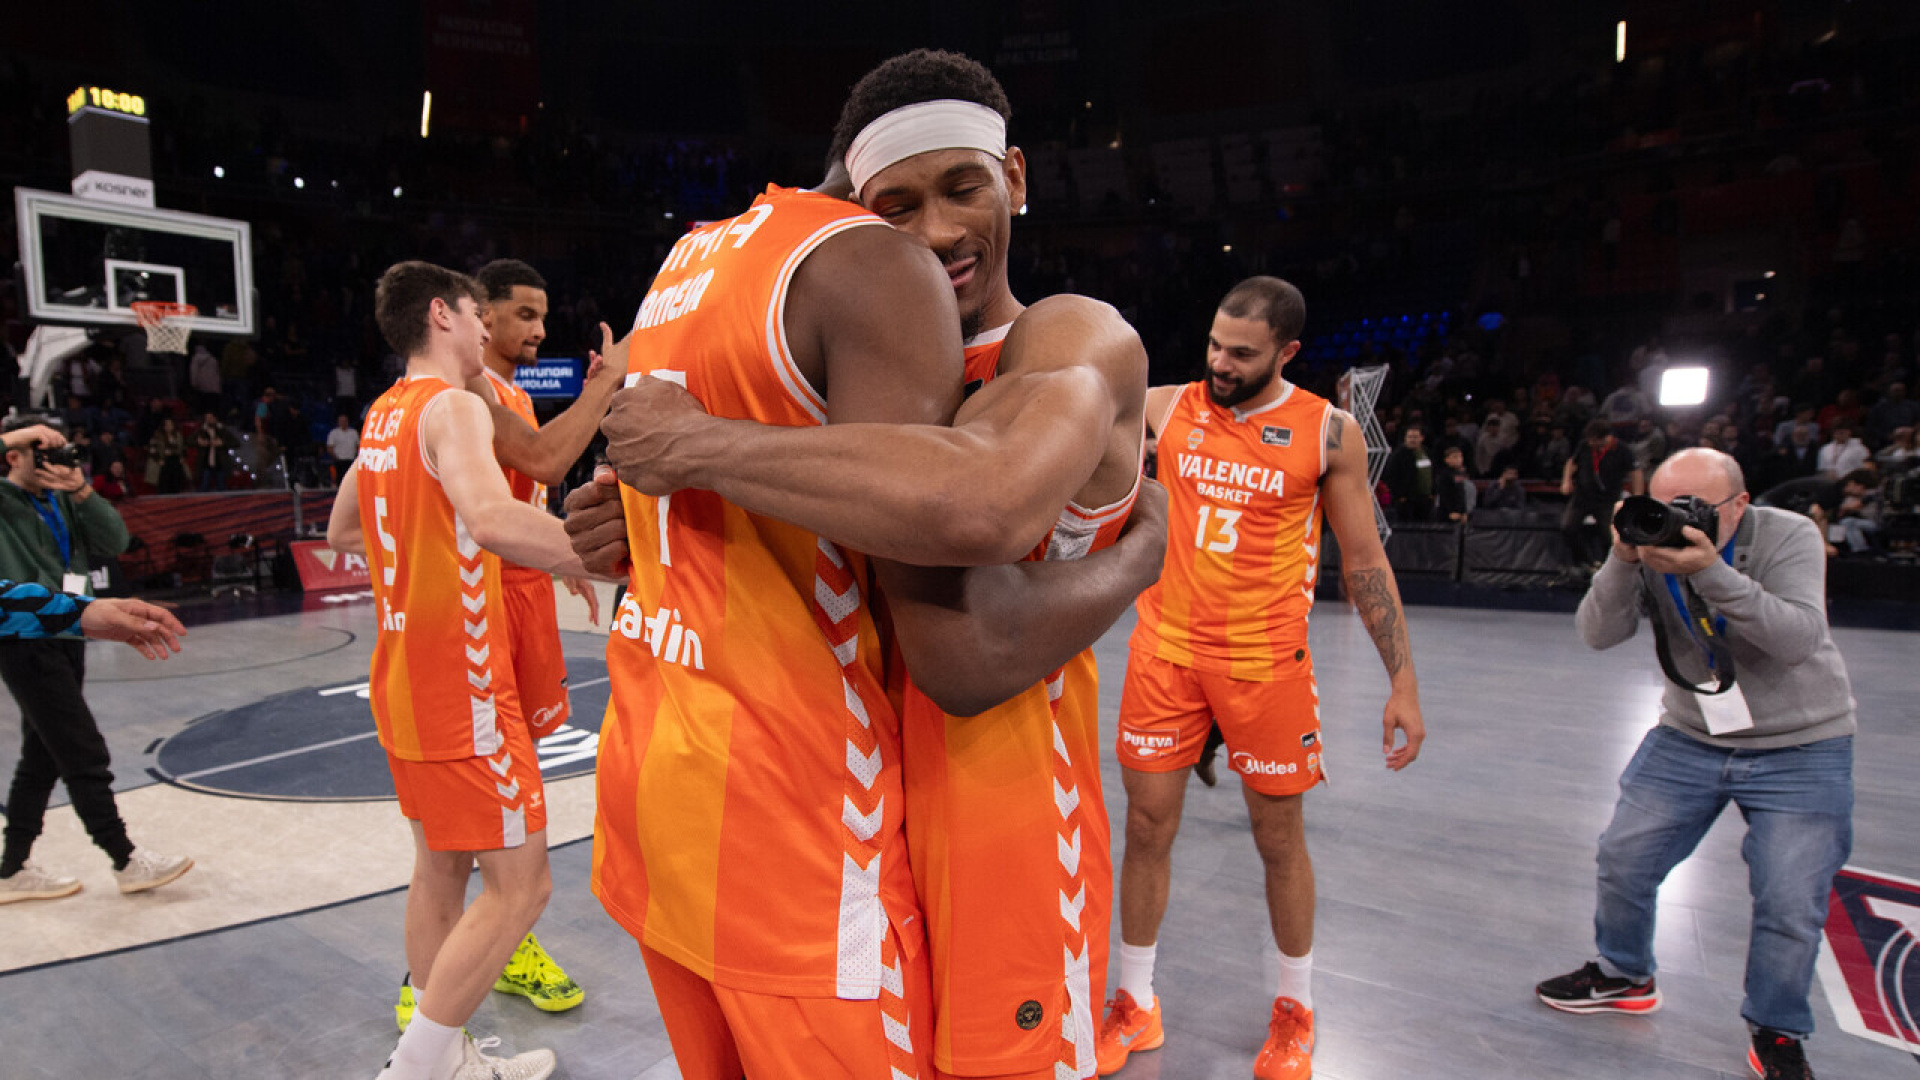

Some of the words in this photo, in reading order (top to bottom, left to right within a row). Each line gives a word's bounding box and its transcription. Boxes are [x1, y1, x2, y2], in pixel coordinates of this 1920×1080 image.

[90, 86, 145, 116] 10:00
[1177, 452, 1285, 498] VALENCIA
[1196, 482, 1253, 505] BASKET
[374, 495, 398, 586] 5
[1194, 505, 1243, 554] 13
[1122, 731, 1174, 748] PULEVA
[1245, 758, 1298, 775] Midea
